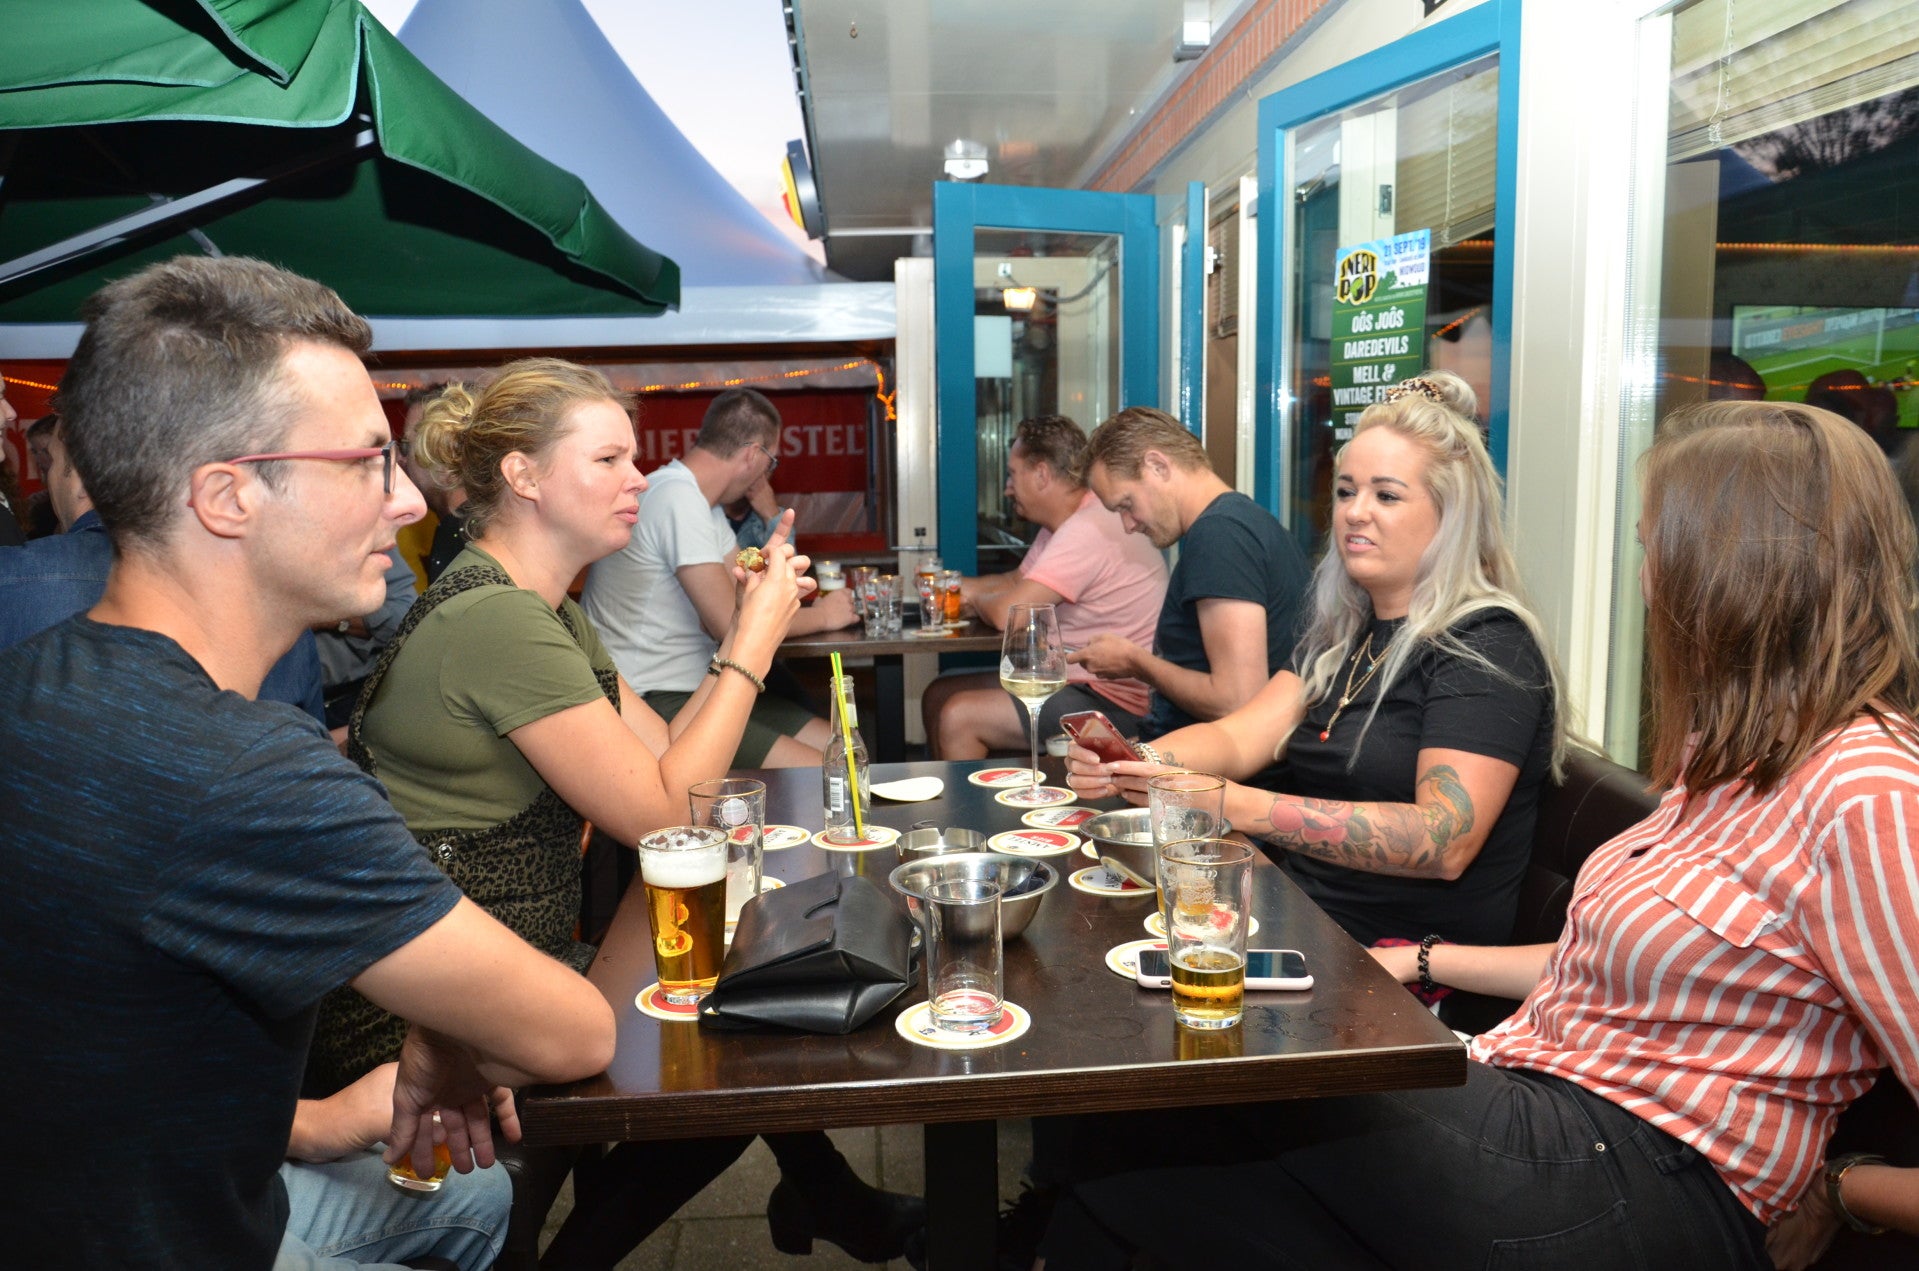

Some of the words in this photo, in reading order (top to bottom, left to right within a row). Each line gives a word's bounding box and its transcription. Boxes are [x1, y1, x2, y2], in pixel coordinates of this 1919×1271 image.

[1339, 274, 1376, 302] POP
[1344, 335, 1409, 359] DAREDEVILS
[1352, 365, 1380, 384] MELL
[1382, 363, 1396, 382] &
[1333, 386, 1373, 405] VINTAGE
[781, 424, 864, 458] STEL
